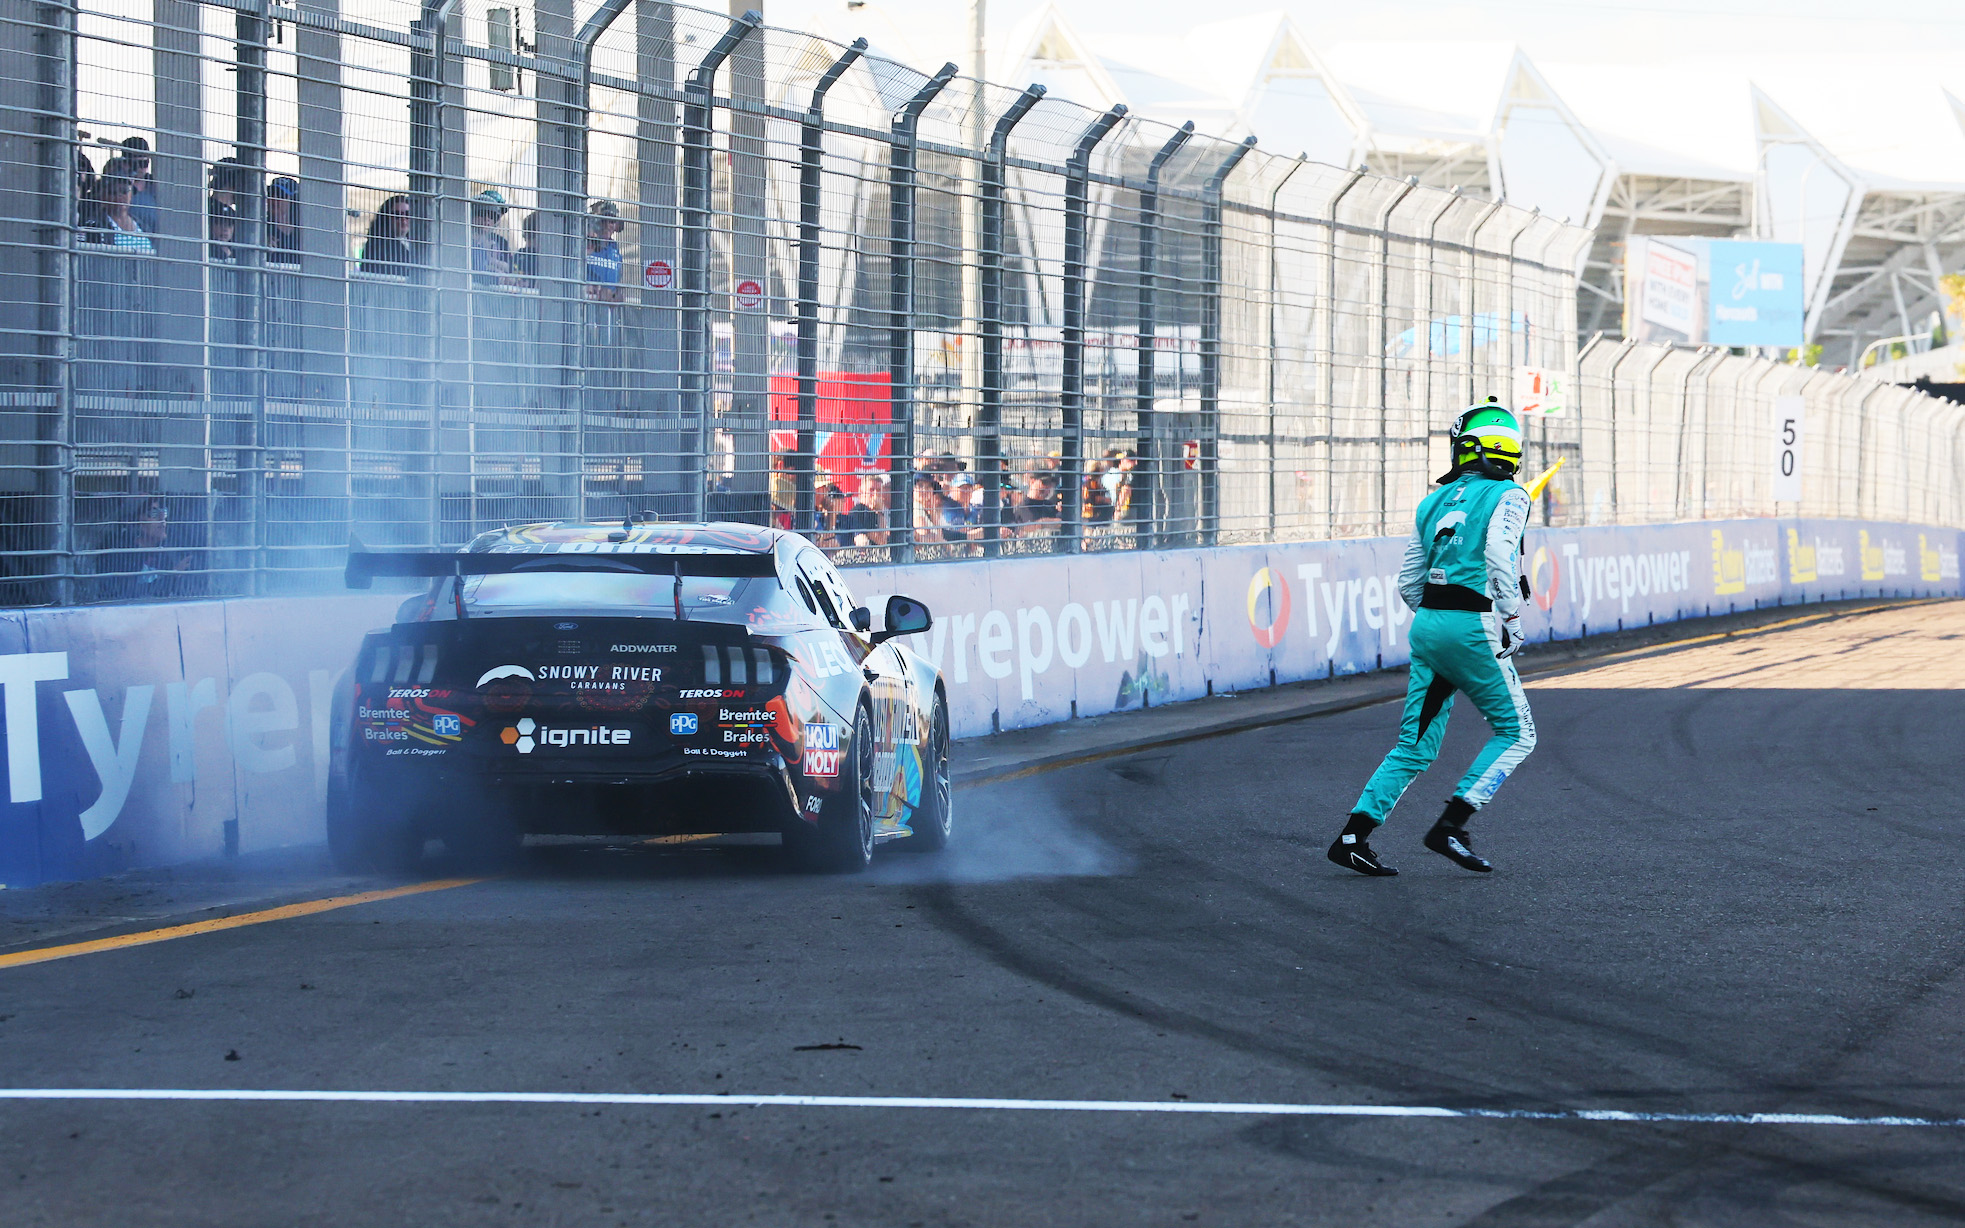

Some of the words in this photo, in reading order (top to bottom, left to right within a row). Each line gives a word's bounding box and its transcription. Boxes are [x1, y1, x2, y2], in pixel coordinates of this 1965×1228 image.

[1562, 543, 1690, 620] Tyrepower
[1297, 563, 1411, 659] Tyrep
[610, 644, 677, 653] ADDWATER
[538, 665, 599, 680] SNOWY
[612, 666, 662, 682] RIVER
[387, 688, 452, 698] TEROSON
[570, 681, 626, 691] CARAVANS
[679, 689, 745, 699] TEROSON
[359, 706, 410, 719] Bremtec
[719, 708, 776, 721] Bremtec
[435, 715, 459, 733] PPG
[671, 715, 697, 732] PPG
[365, 728, 409, 741] Brakes
[541, 725, 632, 748] ignite
[723, 730, 770, 743] Brakes
[806, 725, 837, 750] LIQUI
[805, 752, 838, 774] MOLY
